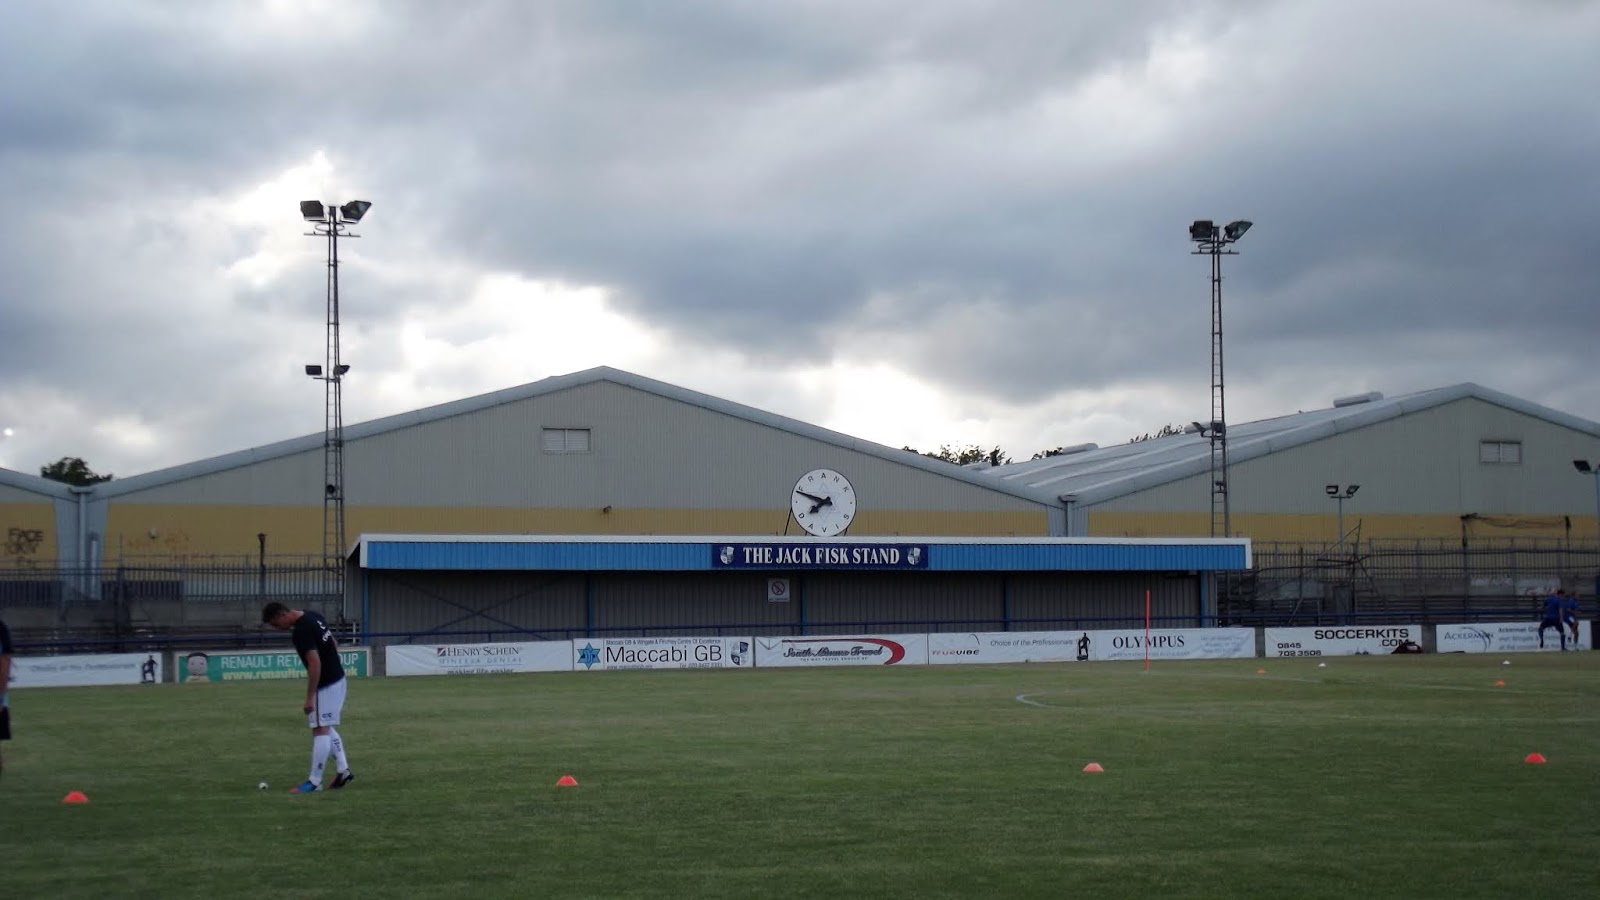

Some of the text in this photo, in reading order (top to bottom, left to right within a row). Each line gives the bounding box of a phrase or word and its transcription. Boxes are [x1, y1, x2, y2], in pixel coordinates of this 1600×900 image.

[798, 472, 850, 493] FRANK
[798, 512, 850, 533] DAVIS
[743, 547, 900, 565] THE JACK FISK STAND
[1314, 628, 1409, 640] SOCCERKITS
[990, 639, 1011, 647] Choice
[1112, 635, 1185, 649] OLYMPUS
[447, 646, 520, 657] HENRY SCHEIN
[606, 644, 722, 663] Maccabi GB
[220, 655, 274, 669] RENAULT
